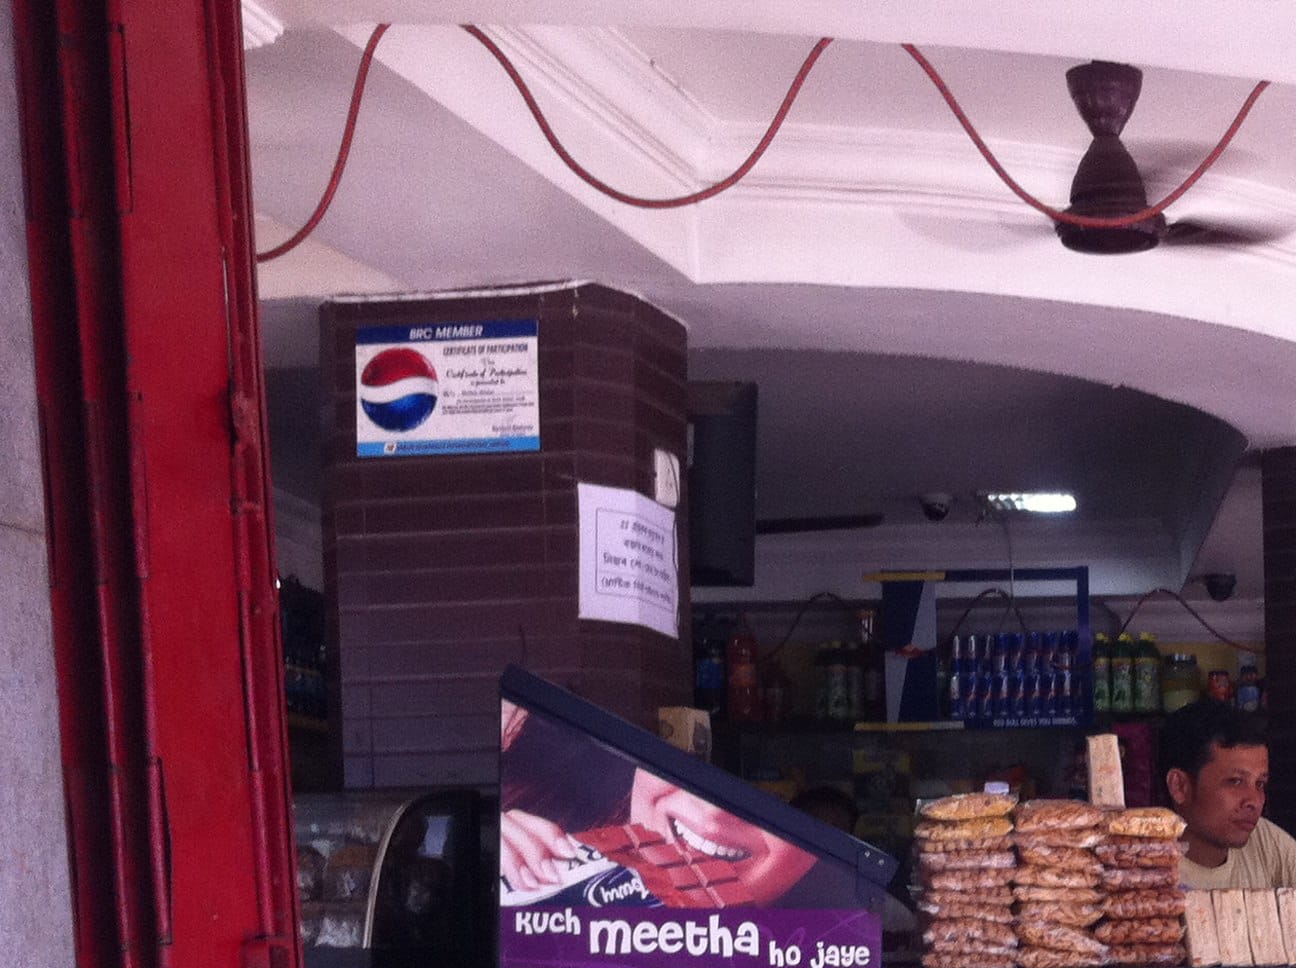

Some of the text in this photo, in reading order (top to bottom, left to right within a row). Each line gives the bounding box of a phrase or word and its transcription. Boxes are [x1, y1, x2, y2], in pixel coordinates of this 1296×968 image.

[435, 325, 484, 338] MEMBER
[443, 343, 528, 356] CERTIFICATE OF PARTICIPATION
[589, 914, 760, 957] meetha
[769, 940, 801, 967] ho
